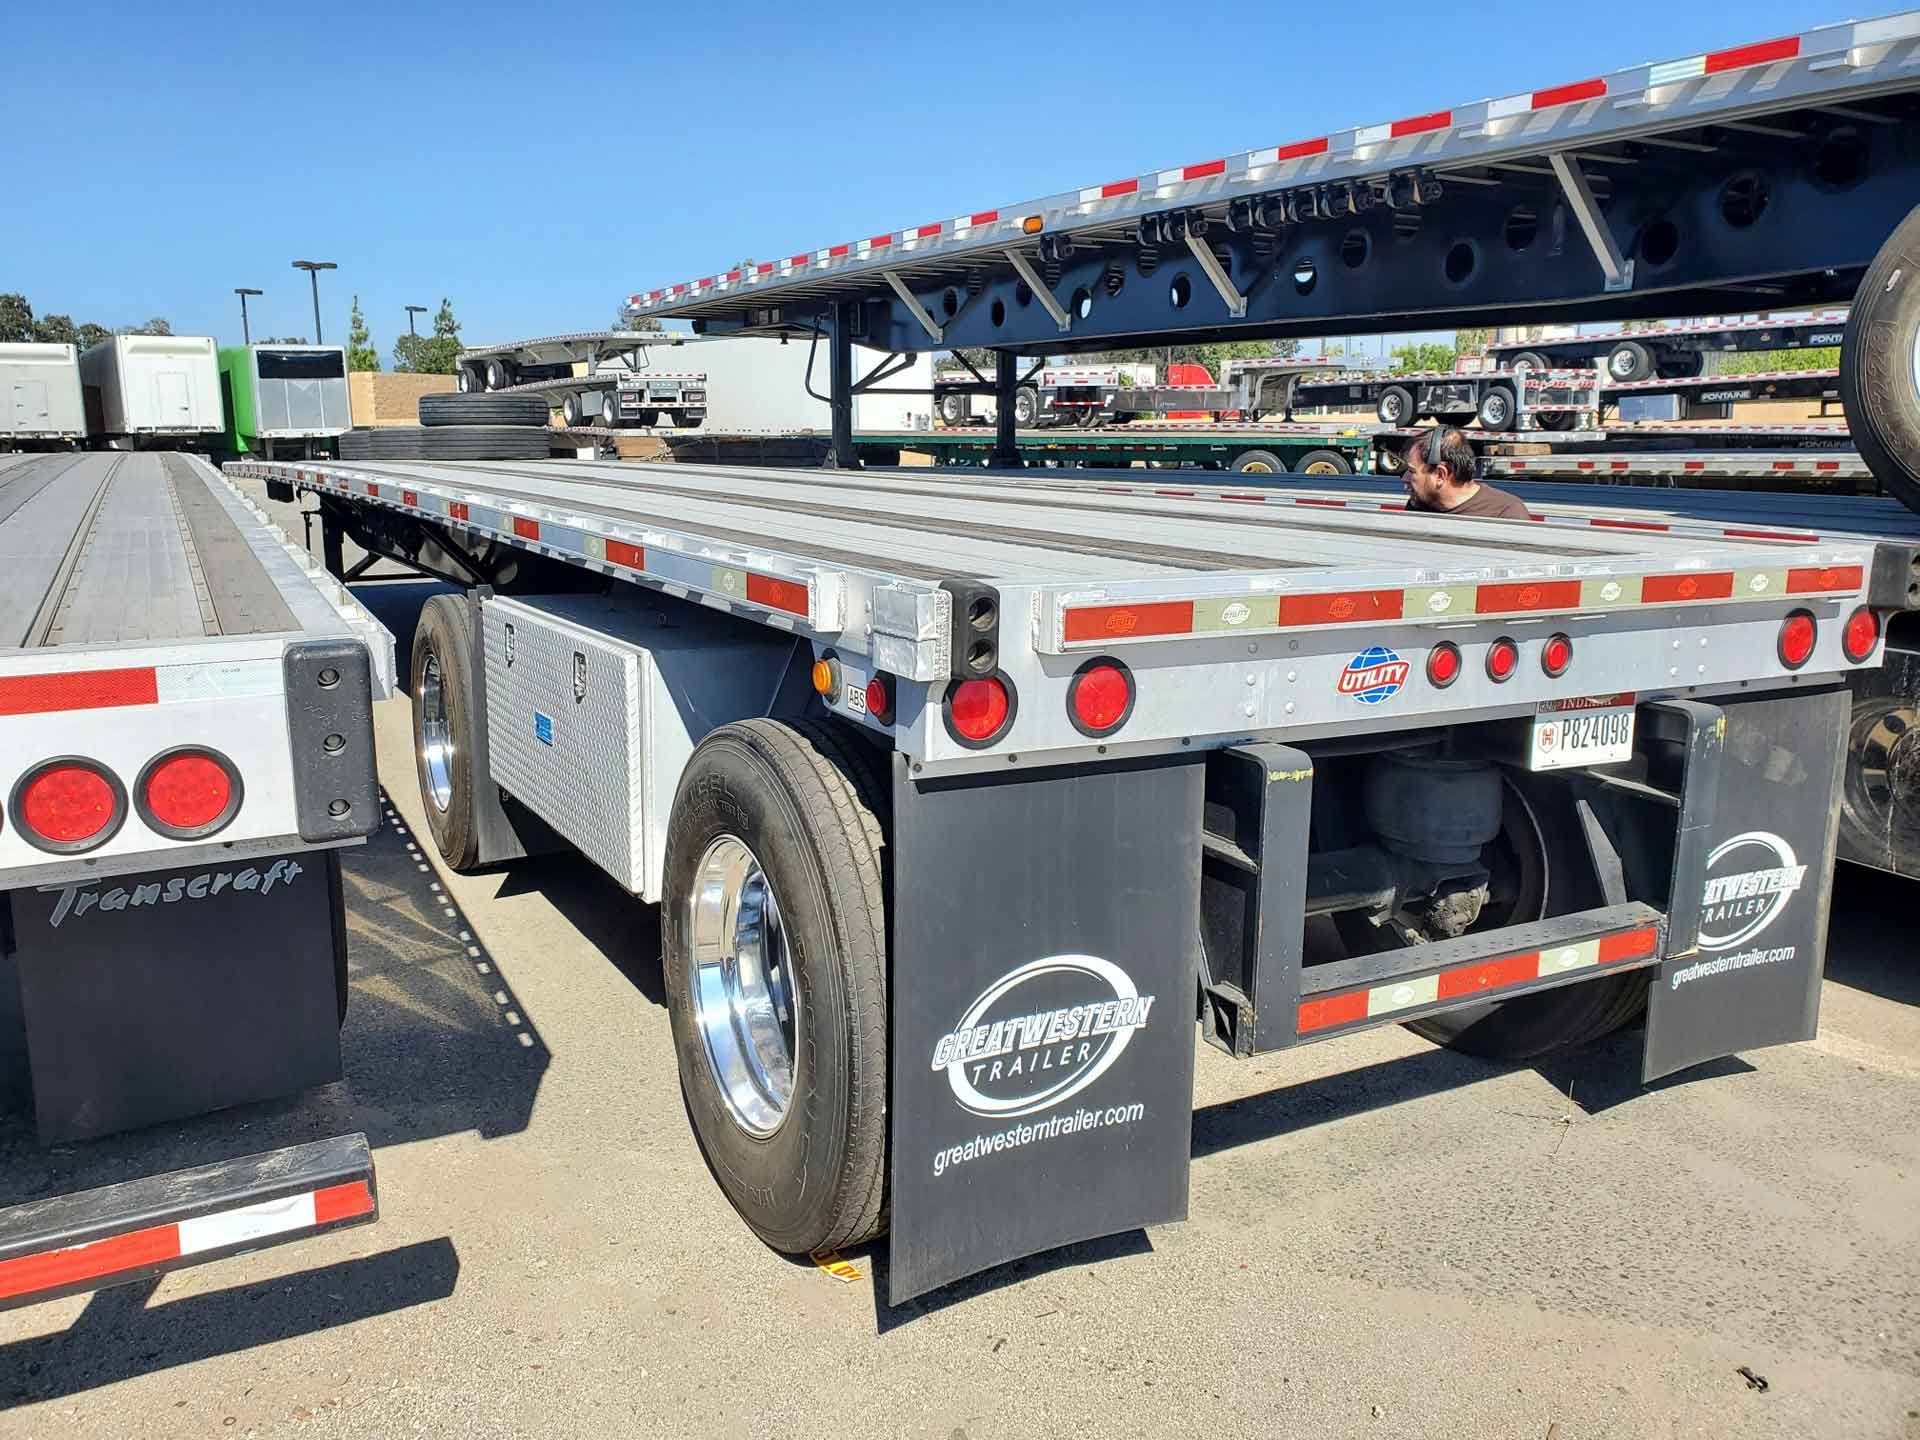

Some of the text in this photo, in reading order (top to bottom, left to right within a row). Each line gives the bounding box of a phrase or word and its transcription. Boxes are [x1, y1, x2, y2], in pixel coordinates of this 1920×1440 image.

[848, 688, 865, 709] ABS
[1341, 664, 1406, 691] UTILITY
[1561, 713, 1630, 751] P824098
[36, 859, 303, 928] Transcraft
[1671, 945, 1796, 991] greatwesterntrailer.com
[931, 995, 1156, 1072] GREATWESTERN
[972, 1041, 1092, 1086] TRAILER
[933, 1103, 1145, 1177] greatwesterntrailer.com
